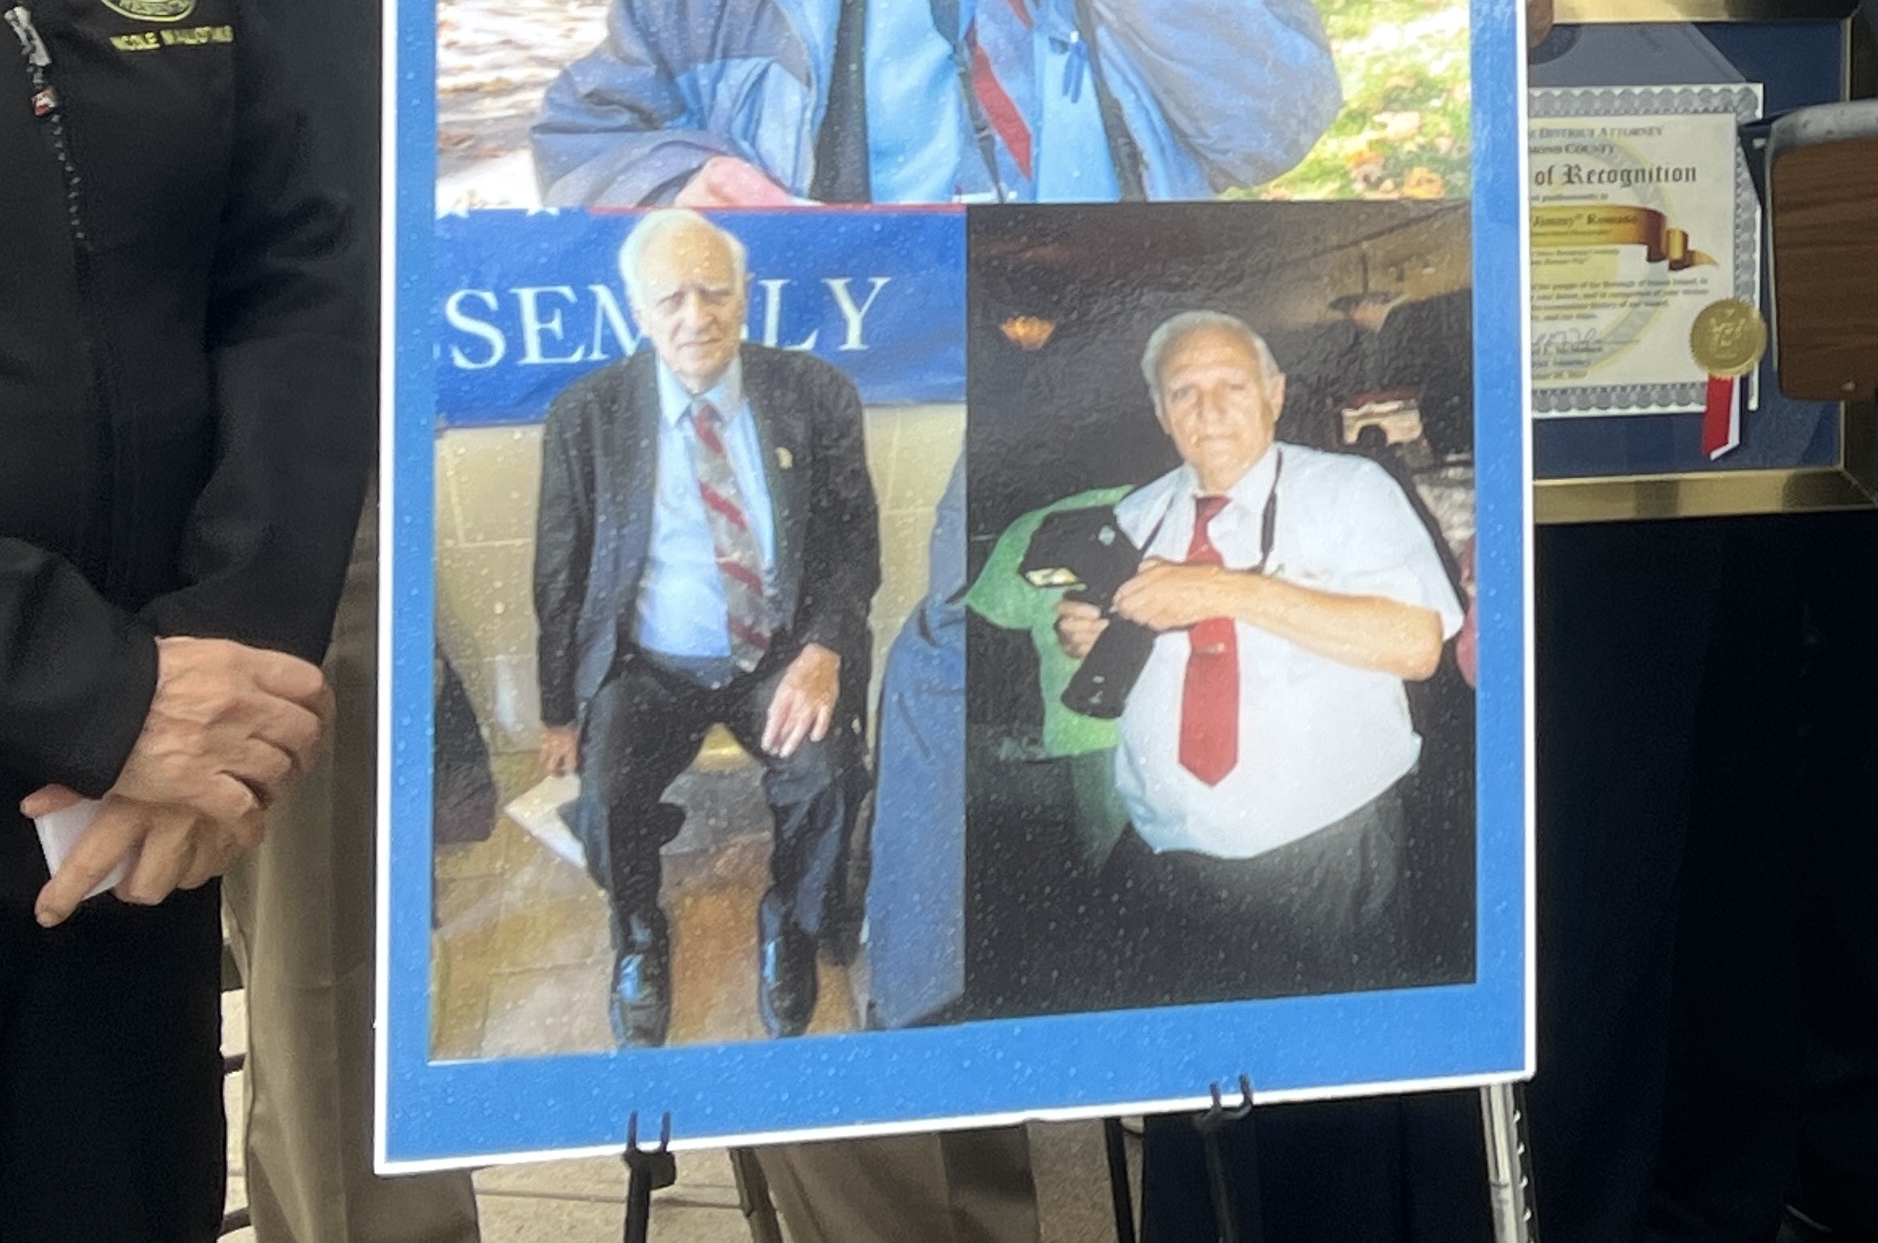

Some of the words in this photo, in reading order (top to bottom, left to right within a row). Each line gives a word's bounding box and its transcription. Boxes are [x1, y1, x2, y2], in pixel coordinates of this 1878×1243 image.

[1534, 165, 1555, 186] of
[1561, 163, 1697, 188] Recognition
[445, 276, 892, 371] SEMLY
